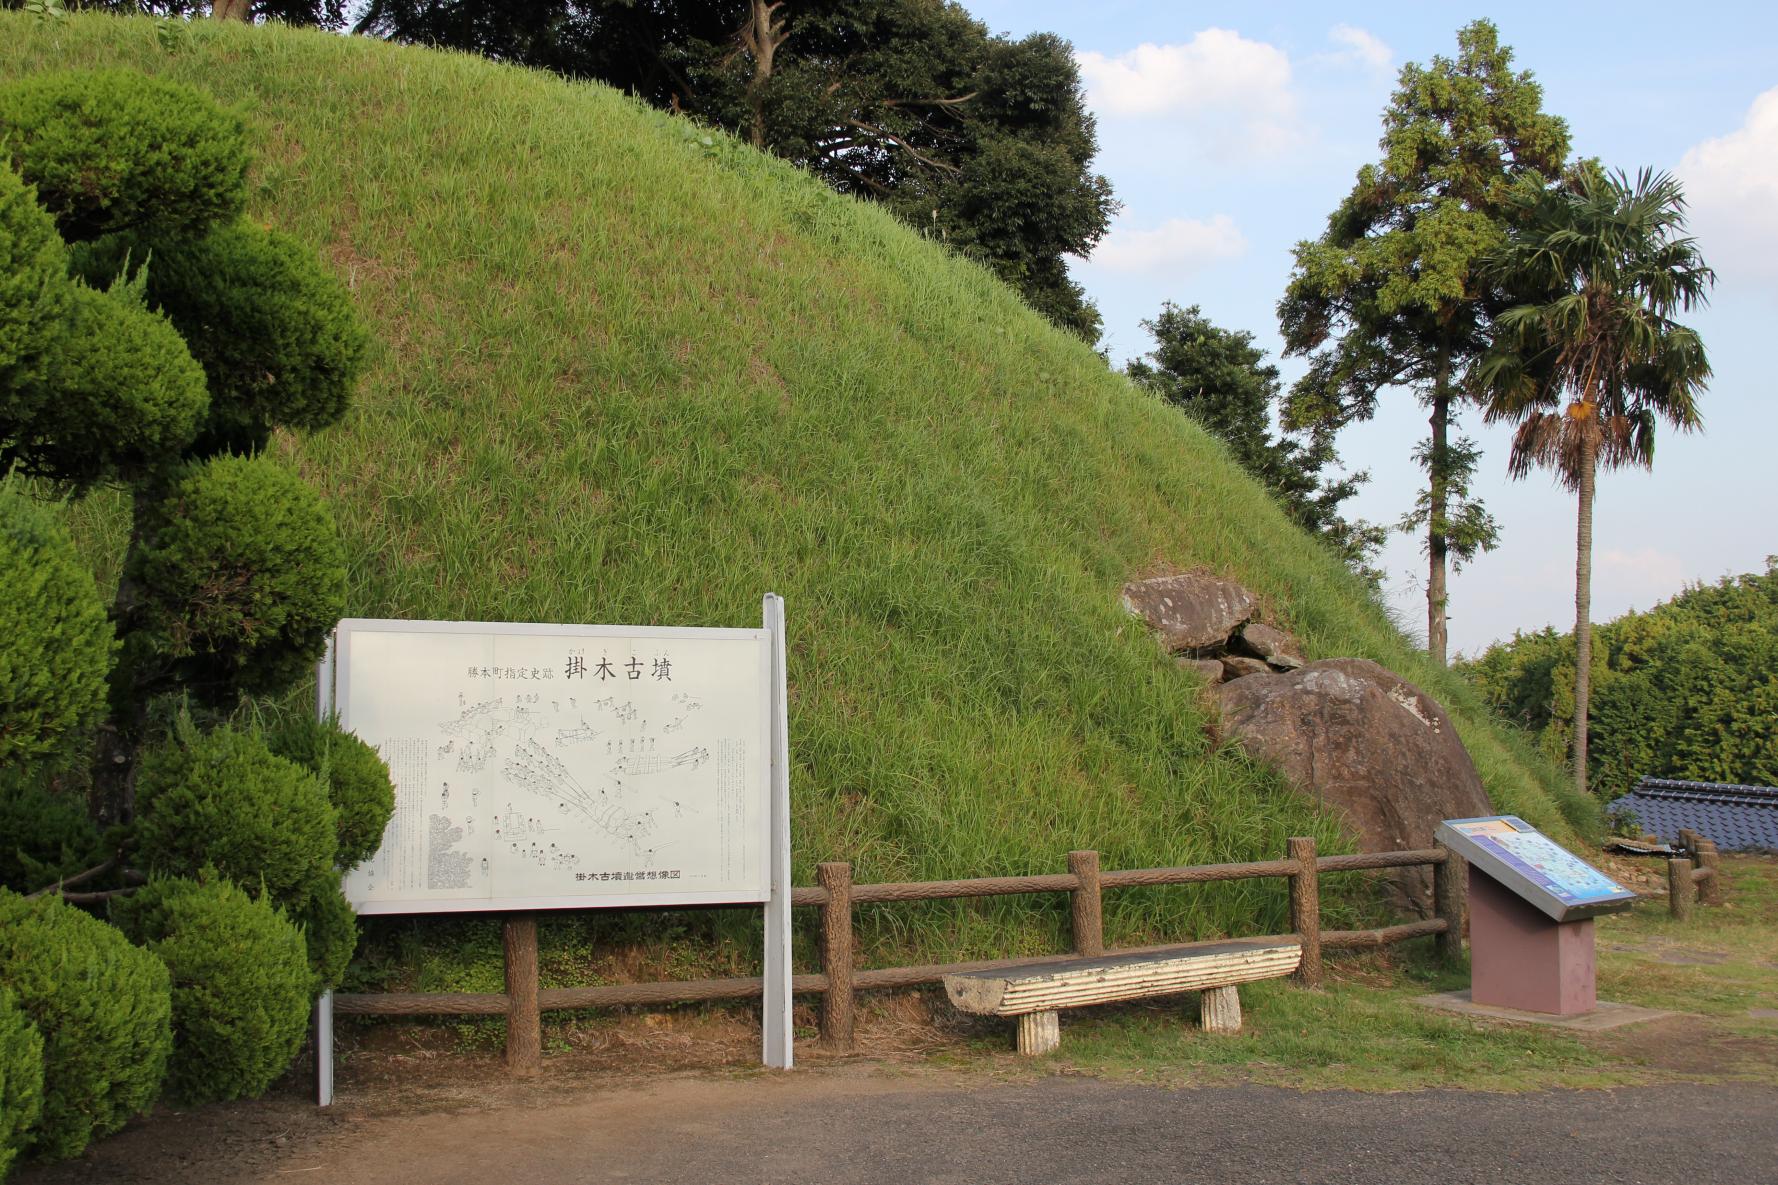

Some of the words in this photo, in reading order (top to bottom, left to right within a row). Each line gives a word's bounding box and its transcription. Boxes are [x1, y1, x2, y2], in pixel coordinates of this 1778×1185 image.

[467, 666, 554, 680] 勝本町指定史跡
[564, 656, 673, 682] 掛木古墳
